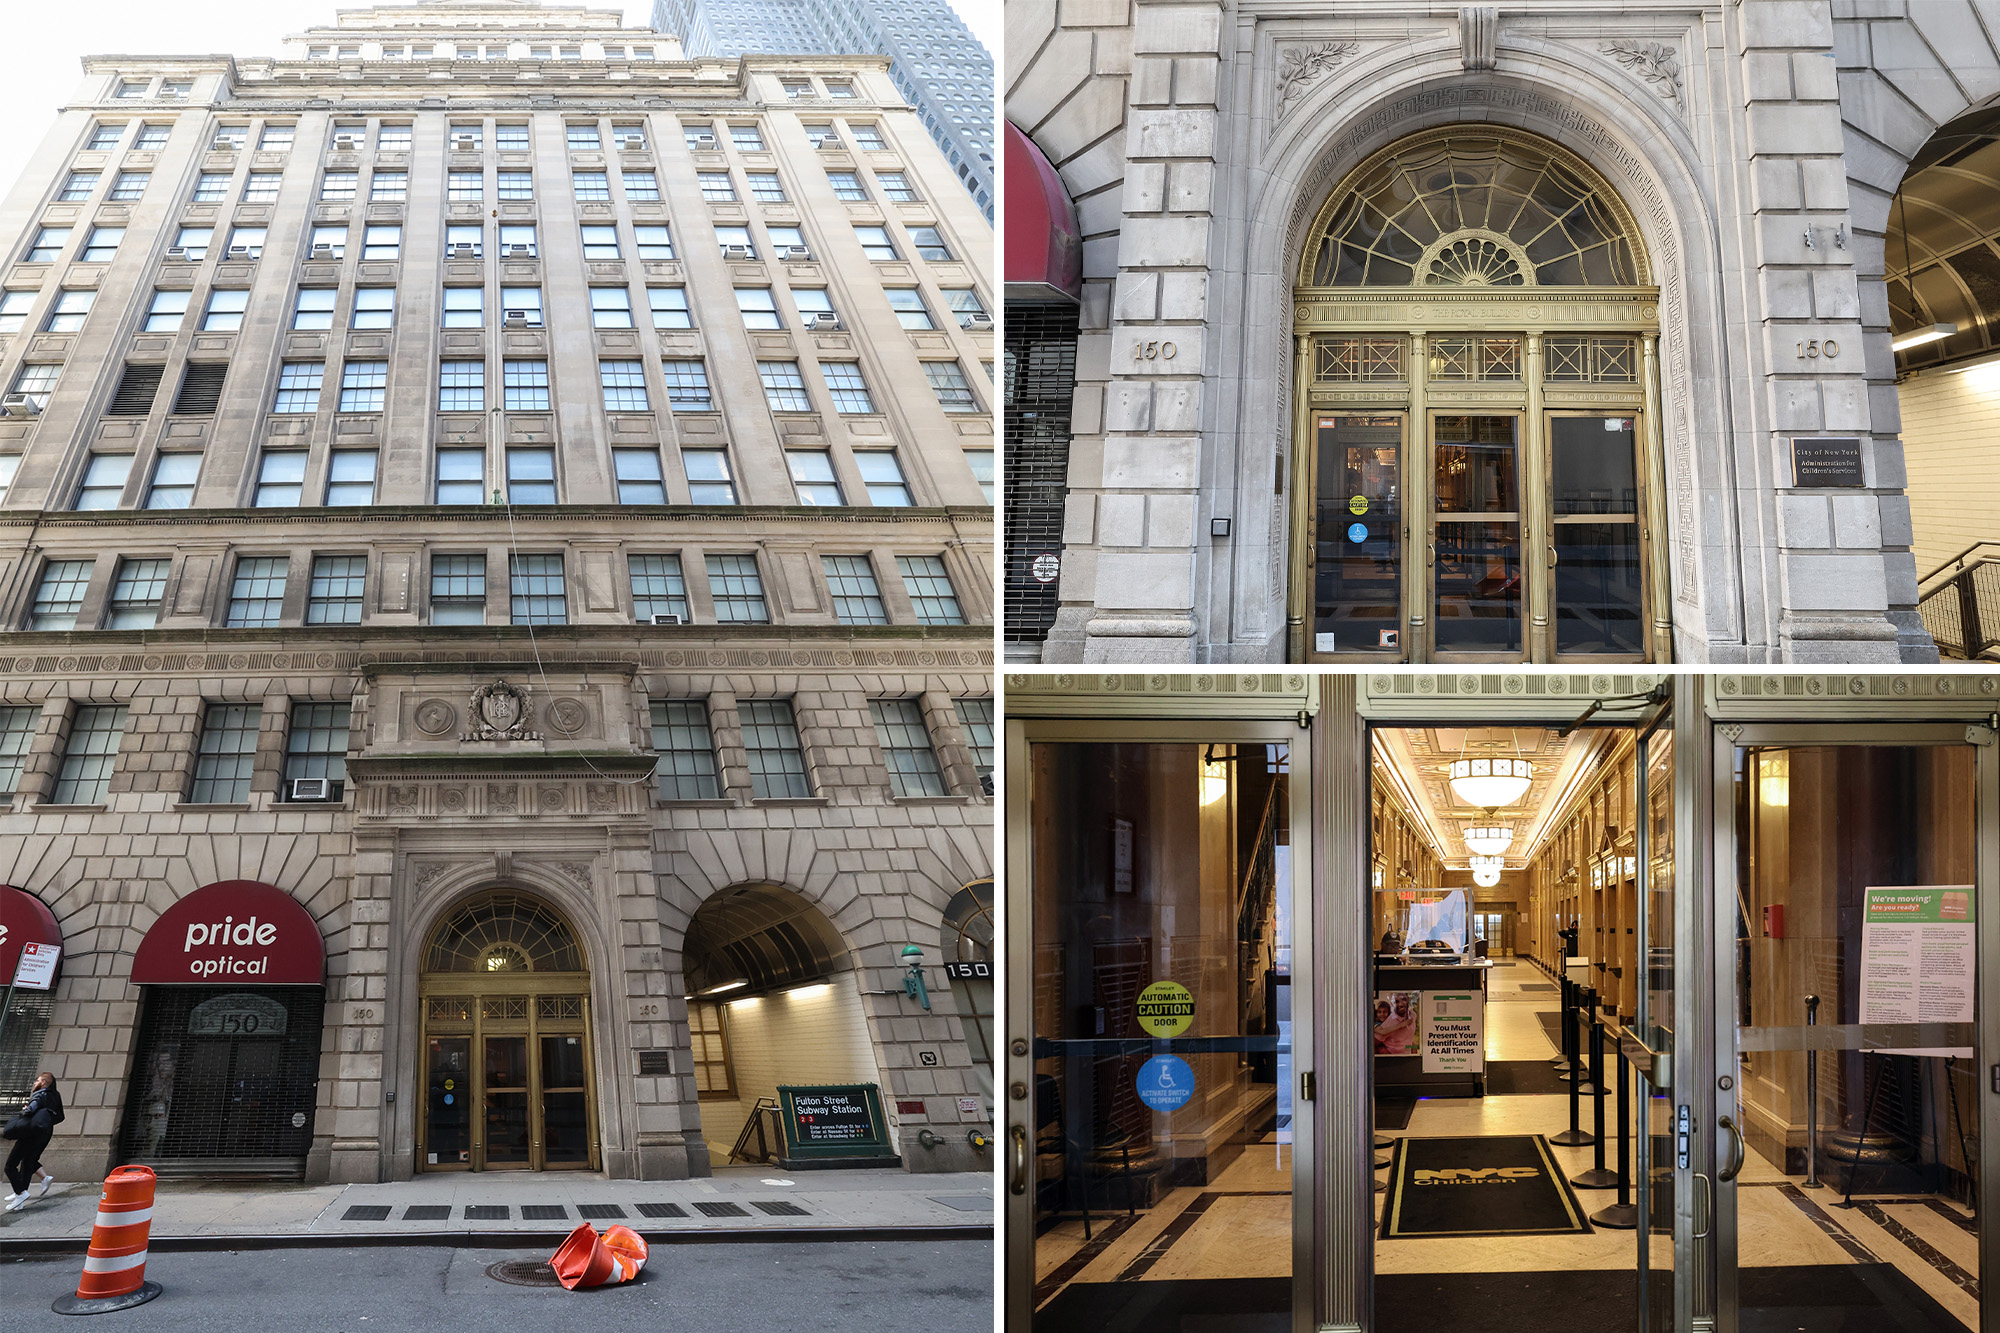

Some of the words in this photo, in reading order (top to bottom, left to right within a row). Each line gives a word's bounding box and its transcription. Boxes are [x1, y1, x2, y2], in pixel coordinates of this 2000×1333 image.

[1135, 341, 1177, 360] 150
[1796, 339, 1839, 359] 150
[1796, 449, 1812, 457] City
[1871, 895, 1896, 903] We're
[1897, 895, 1932, 904] moving!
[1896, 904, 1920, 912] ready?
[184, 915, 277, 952] pride
[190, 956, 268, 978] optical
[949, 964, 990, 977] 150
[1141, 993, 1190, 1001] AUTOMATIC
[353, 1007, 374, 1019] 150
[640, 1005, 659, 1016] 150
[1138, 1004, 1191, 1015] CAUTION
[221, 1014, 259, 1034] 150
[1153, 1018, 1178, 1027] DOOR
[795, 1097, 821, 1106] Fulton
[823, 1096, 849, 1105] Street
[1157, 1096, 1182, 1104] OPERATE
[797, 1106, 829, 1116] Subway
[831, 1105, 862, 1114] Station
[1414, 1166, 1540, 1180] NYC
[1414, 1178, 1517, 1186] Children
